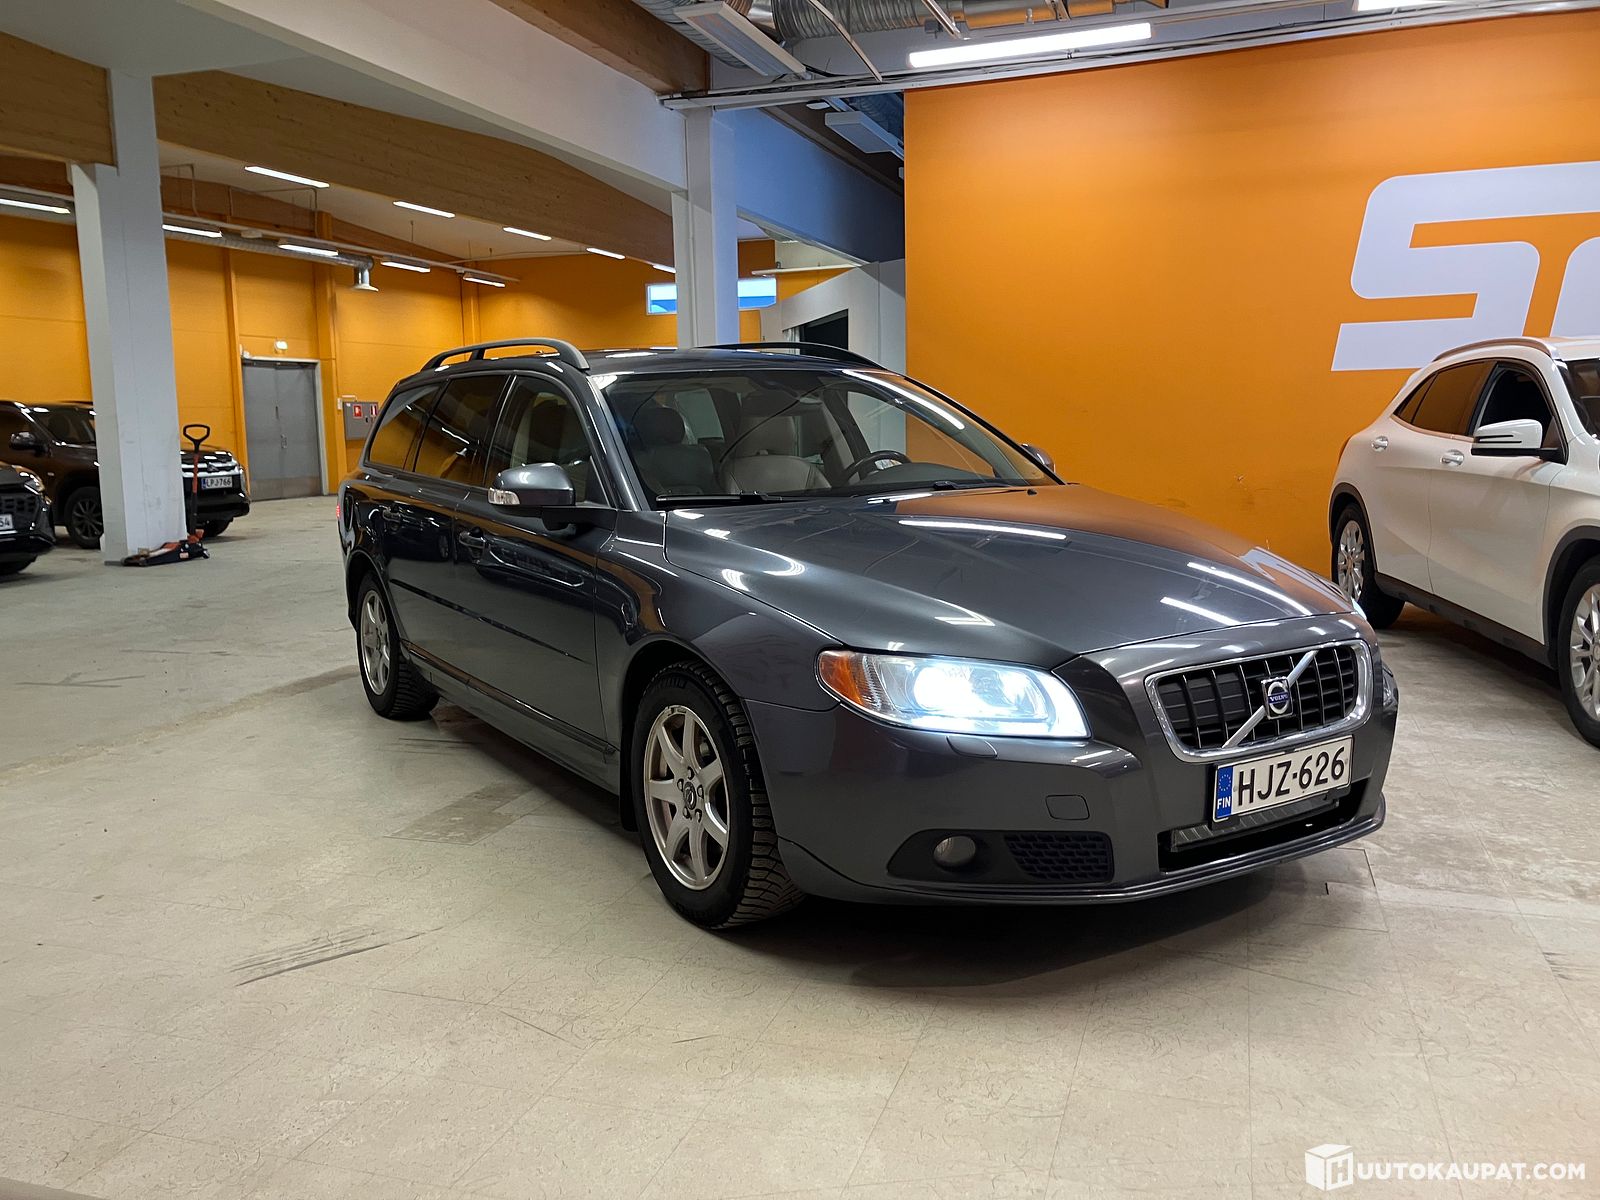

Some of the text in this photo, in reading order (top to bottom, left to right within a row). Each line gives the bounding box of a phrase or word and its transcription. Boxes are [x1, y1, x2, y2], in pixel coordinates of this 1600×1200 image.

[1331, 161, 1600, 371] S
[1270, 694, 1288, 702] VOLVO
[1238, 746, 1345, 806] HJZ-626
[1217, 796, 1231, 809] FIN
